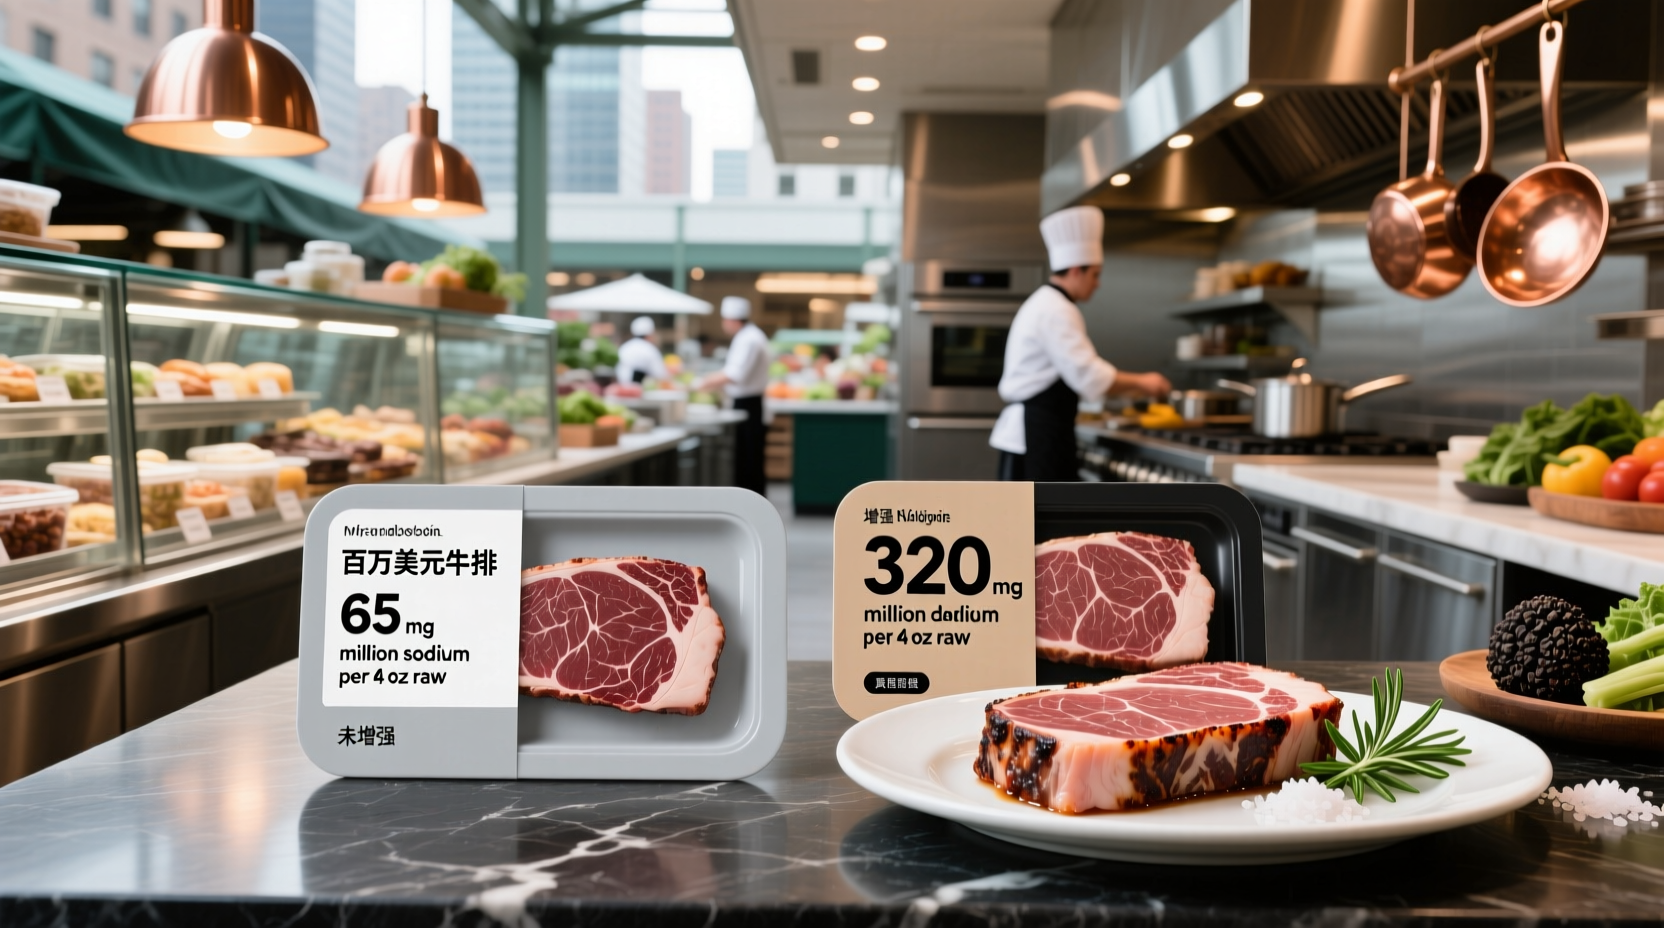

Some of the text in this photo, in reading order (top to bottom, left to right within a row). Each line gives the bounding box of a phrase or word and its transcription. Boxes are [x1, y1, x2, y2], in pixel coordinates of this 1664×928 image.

[342, 549, 497, 576] 百万美元牛排
[864, 535, 1022, 599] 320 mg
[341, 593, 434, 639] 65 mg
[865, 605, 925, 622] million
[864, 629, 970, 649] per 4 oz raw
[340, 645, 469, 661] million sodium
[339, 668, 446, 688] per 4 oz raw
[338, 725, 394, 746] 未增强
